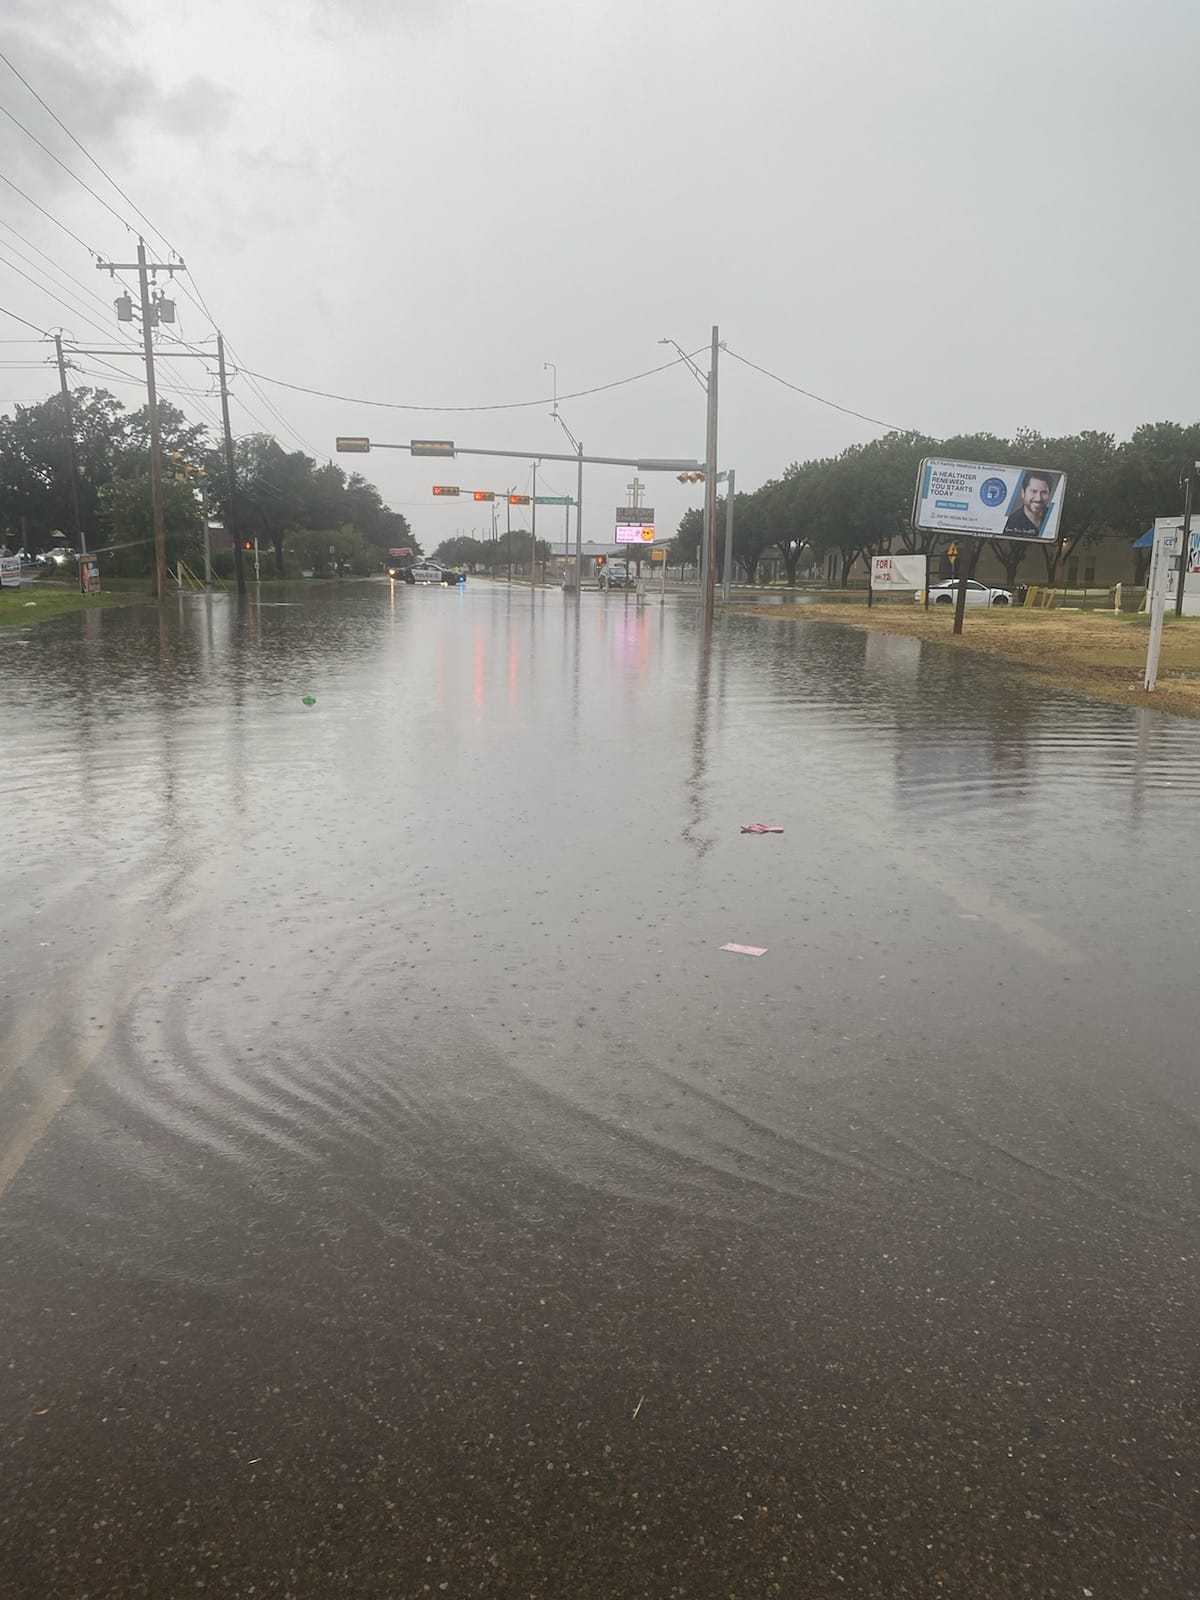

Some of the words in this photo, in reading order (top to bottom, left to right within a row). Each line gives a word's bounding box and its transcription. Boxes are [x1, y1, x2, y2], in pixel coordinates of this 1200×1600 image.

[939, 471, 977, 481] HEALTHIER
[931, 477, 966, 486] RENEWED
[931, 483, 946, 491] YOU
[946, 484, 973, 493] STARTS
[876, 559, 888, 569] FOR
